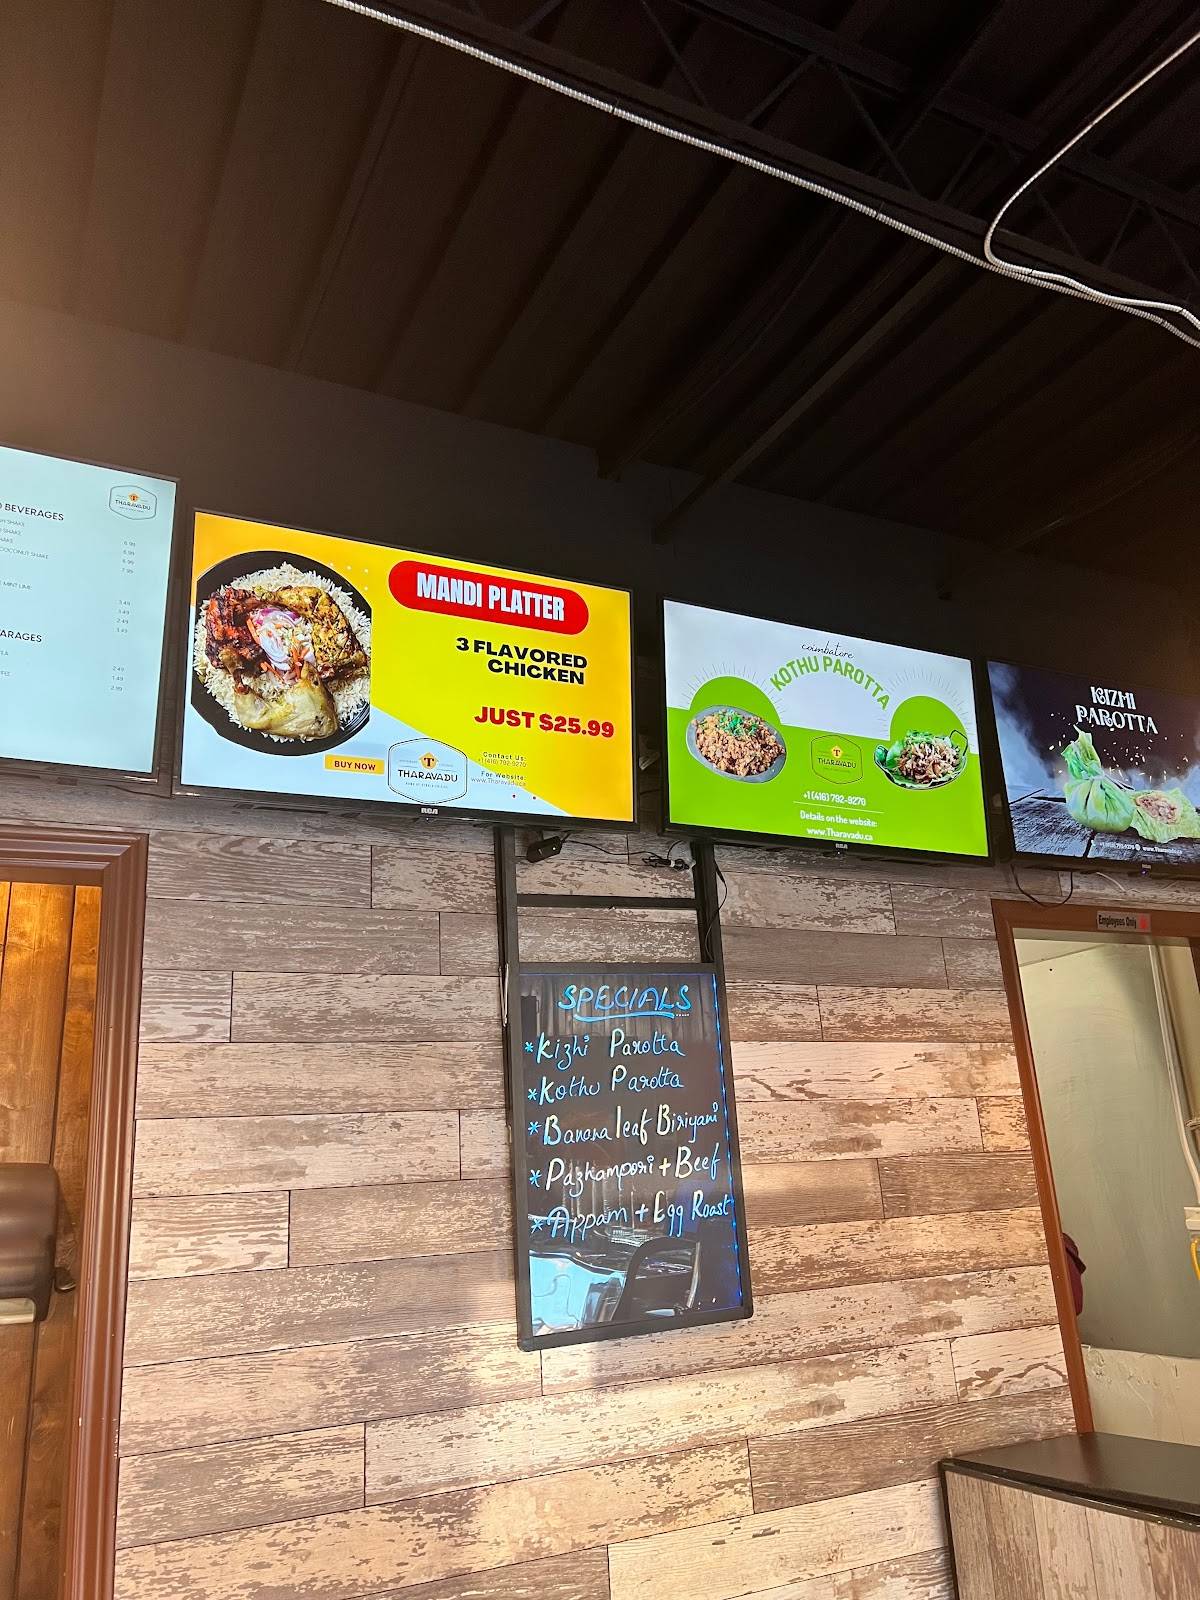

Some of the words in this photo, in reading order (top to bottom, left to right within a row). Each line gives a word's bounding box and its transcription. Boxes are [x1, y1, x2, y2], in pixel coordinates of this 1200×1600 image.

[4, 503, 64, 521] BEVERAGES
[416, 572, 482, 608] MANDI
[488, 584, 565, 622] PLATTER
[0, 629, 42, 643] ARAGES
[456, 637, 470, 652] 3
[473, 640, 588, 669] FLAVORED
[801, 641, 854, 660] coimbatore
[488, 658, 585, 685] CHICKEN
[770, 656, 820, 692] KOTHU
[822, 656, 890, 711] PAROTTA
[1090, 686, 1136, 710] KIZHI
[474, 706, 535, 729] JUST
[539, 712, 615, 738] $25.99
[1075, 704, 1158, 734] PAROTTA
[334, 760, 352, 768] BUY
[354, 762, 376, 771] NOW
[482, 752, 512, 760] Contact
[818, 758, 856, 769] THARAVADU
[398, 769, 458, 782] THARAVADU
[480, 770, 492, 778] For
[800, 810, 825, 822] Details
[826, 814, 834, 822] on
[834, 814, 848, 824] the
[1098, 914, 1125, 928] Employees
[558, 984, 692, 1013] SPECIALS
[610, 1027, 686, 1058] Parotta
[538, 1075, 600, 1106] Kothu
[610, 1064, 685, 1092] Parotta
[543, 1114, 613, 1146] Banana
[674, 1142, 721, 1181] Beef
[546, 1206, 628, 1244] Appam
[653, 1190, 684, 1238] Egg
[692, 1190, 735, 1221] Roast
